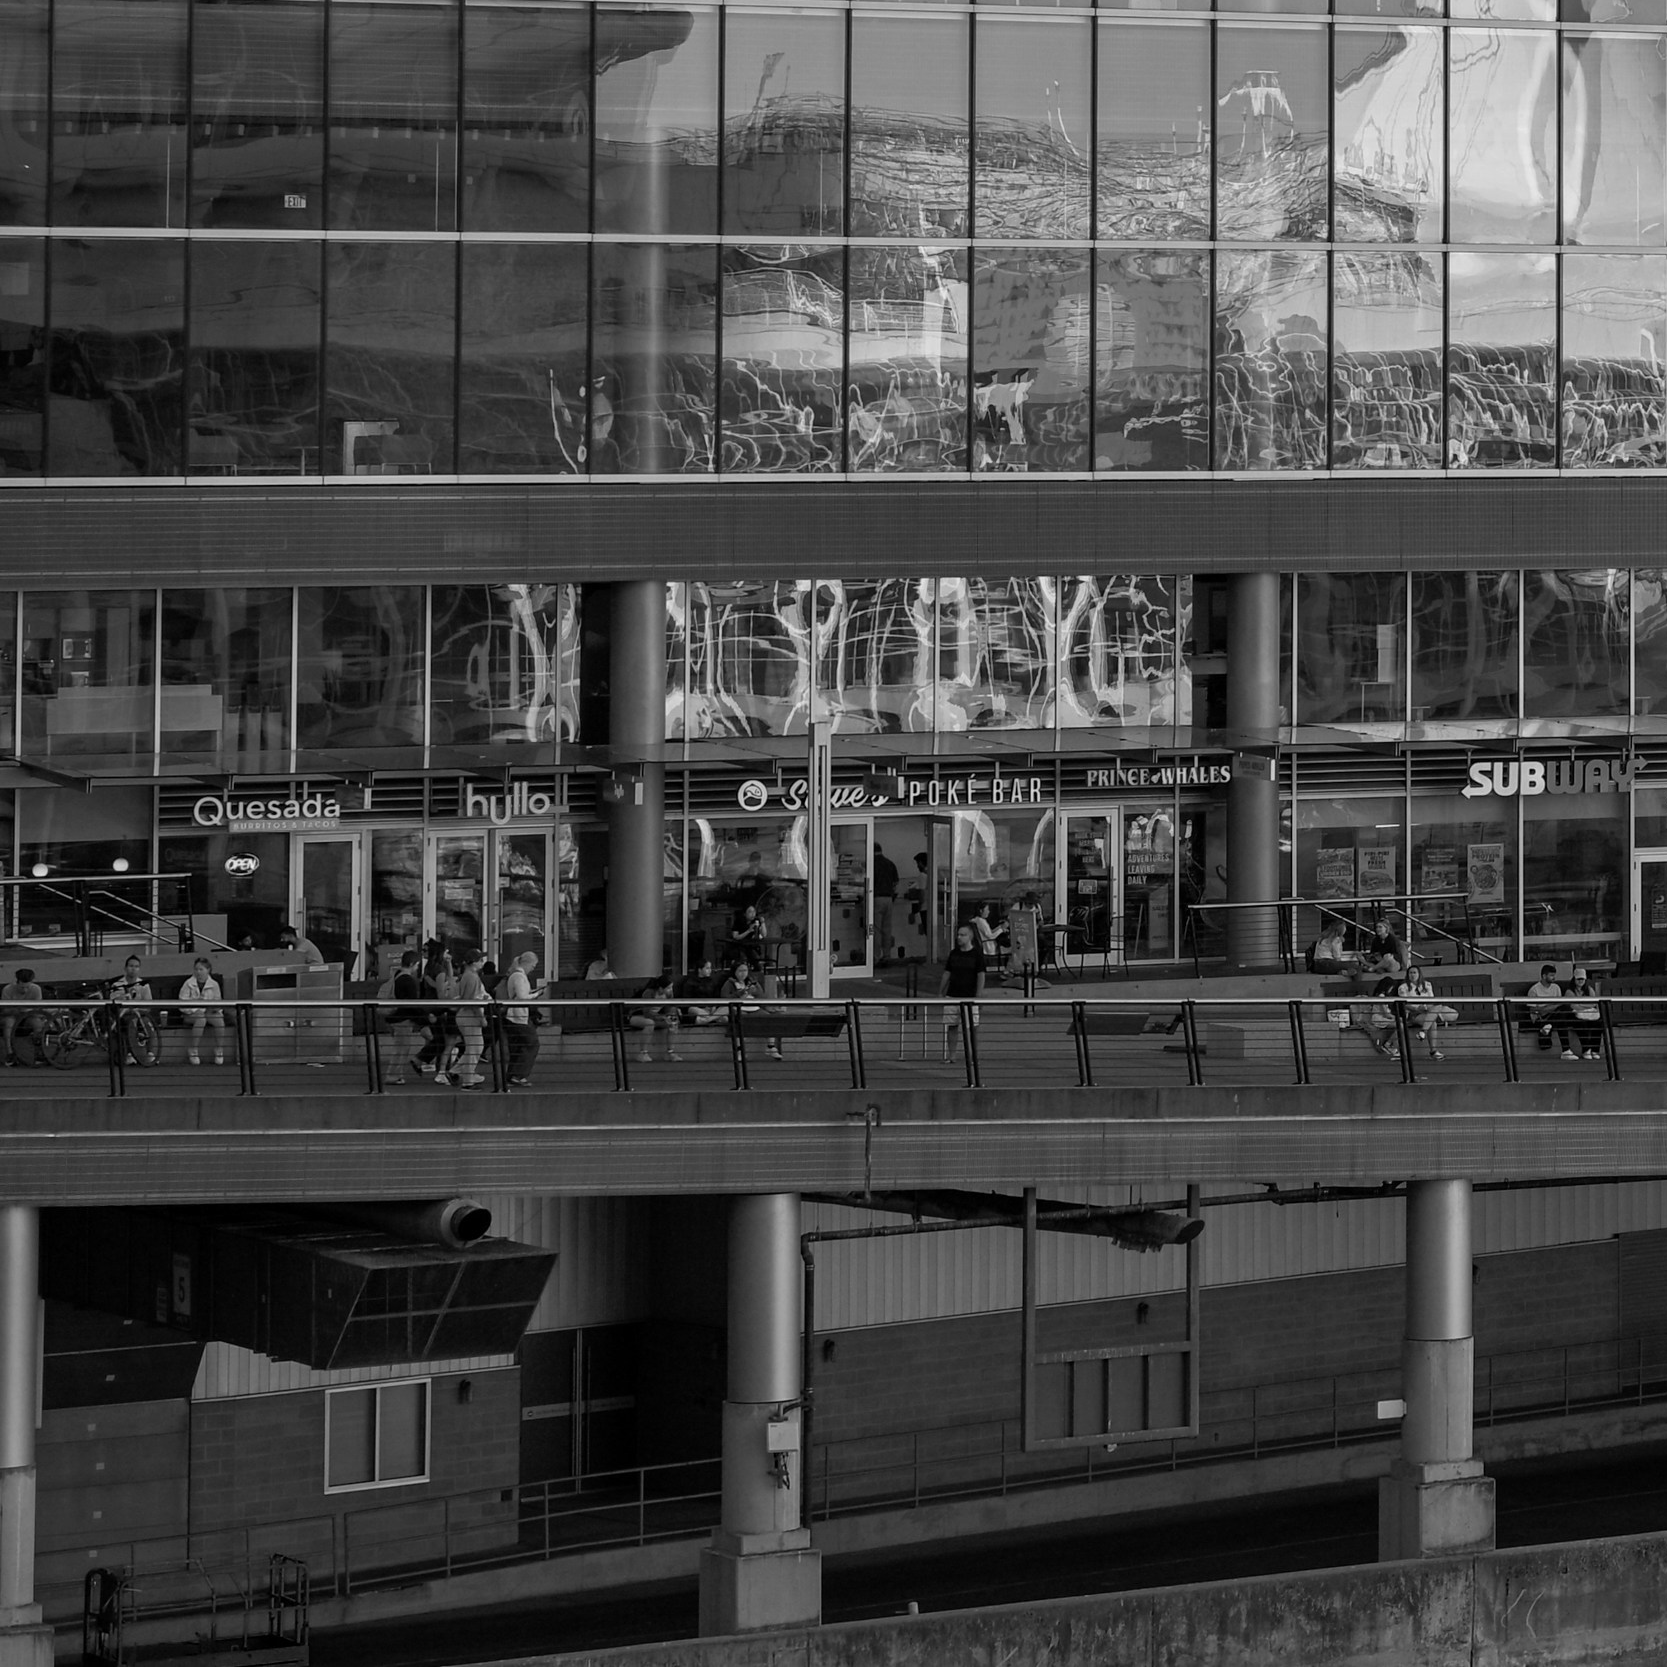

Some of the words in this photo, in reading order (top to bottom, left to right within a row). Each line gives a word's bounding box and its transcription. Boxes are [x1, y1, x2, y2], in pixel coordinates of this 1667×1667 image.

[1087, 768, 1150, 787] PRINCE
[1161, 766, 1231, 785] WHALES
[1460, 755, 1648, 799] SUBWAY
[909, 773, 977, 806] POKÉ
[992, 777, 1041, 804] BAR
[193, 793, 341, 826] Quesada
[466, 781, 551, 825] hullo
[233, 821, 287, 830] BURRITOS
[302, 820, 336, 828] TACOS
[226, 856, 257, 872] OPEN
[1127, 853, 1170, 863] ADVENTURES
[1127, 865, 1155, 874] LEAVING
[1127, 875, 1148, 885] DAILY
[178, 1277, 185, 1303] 5
